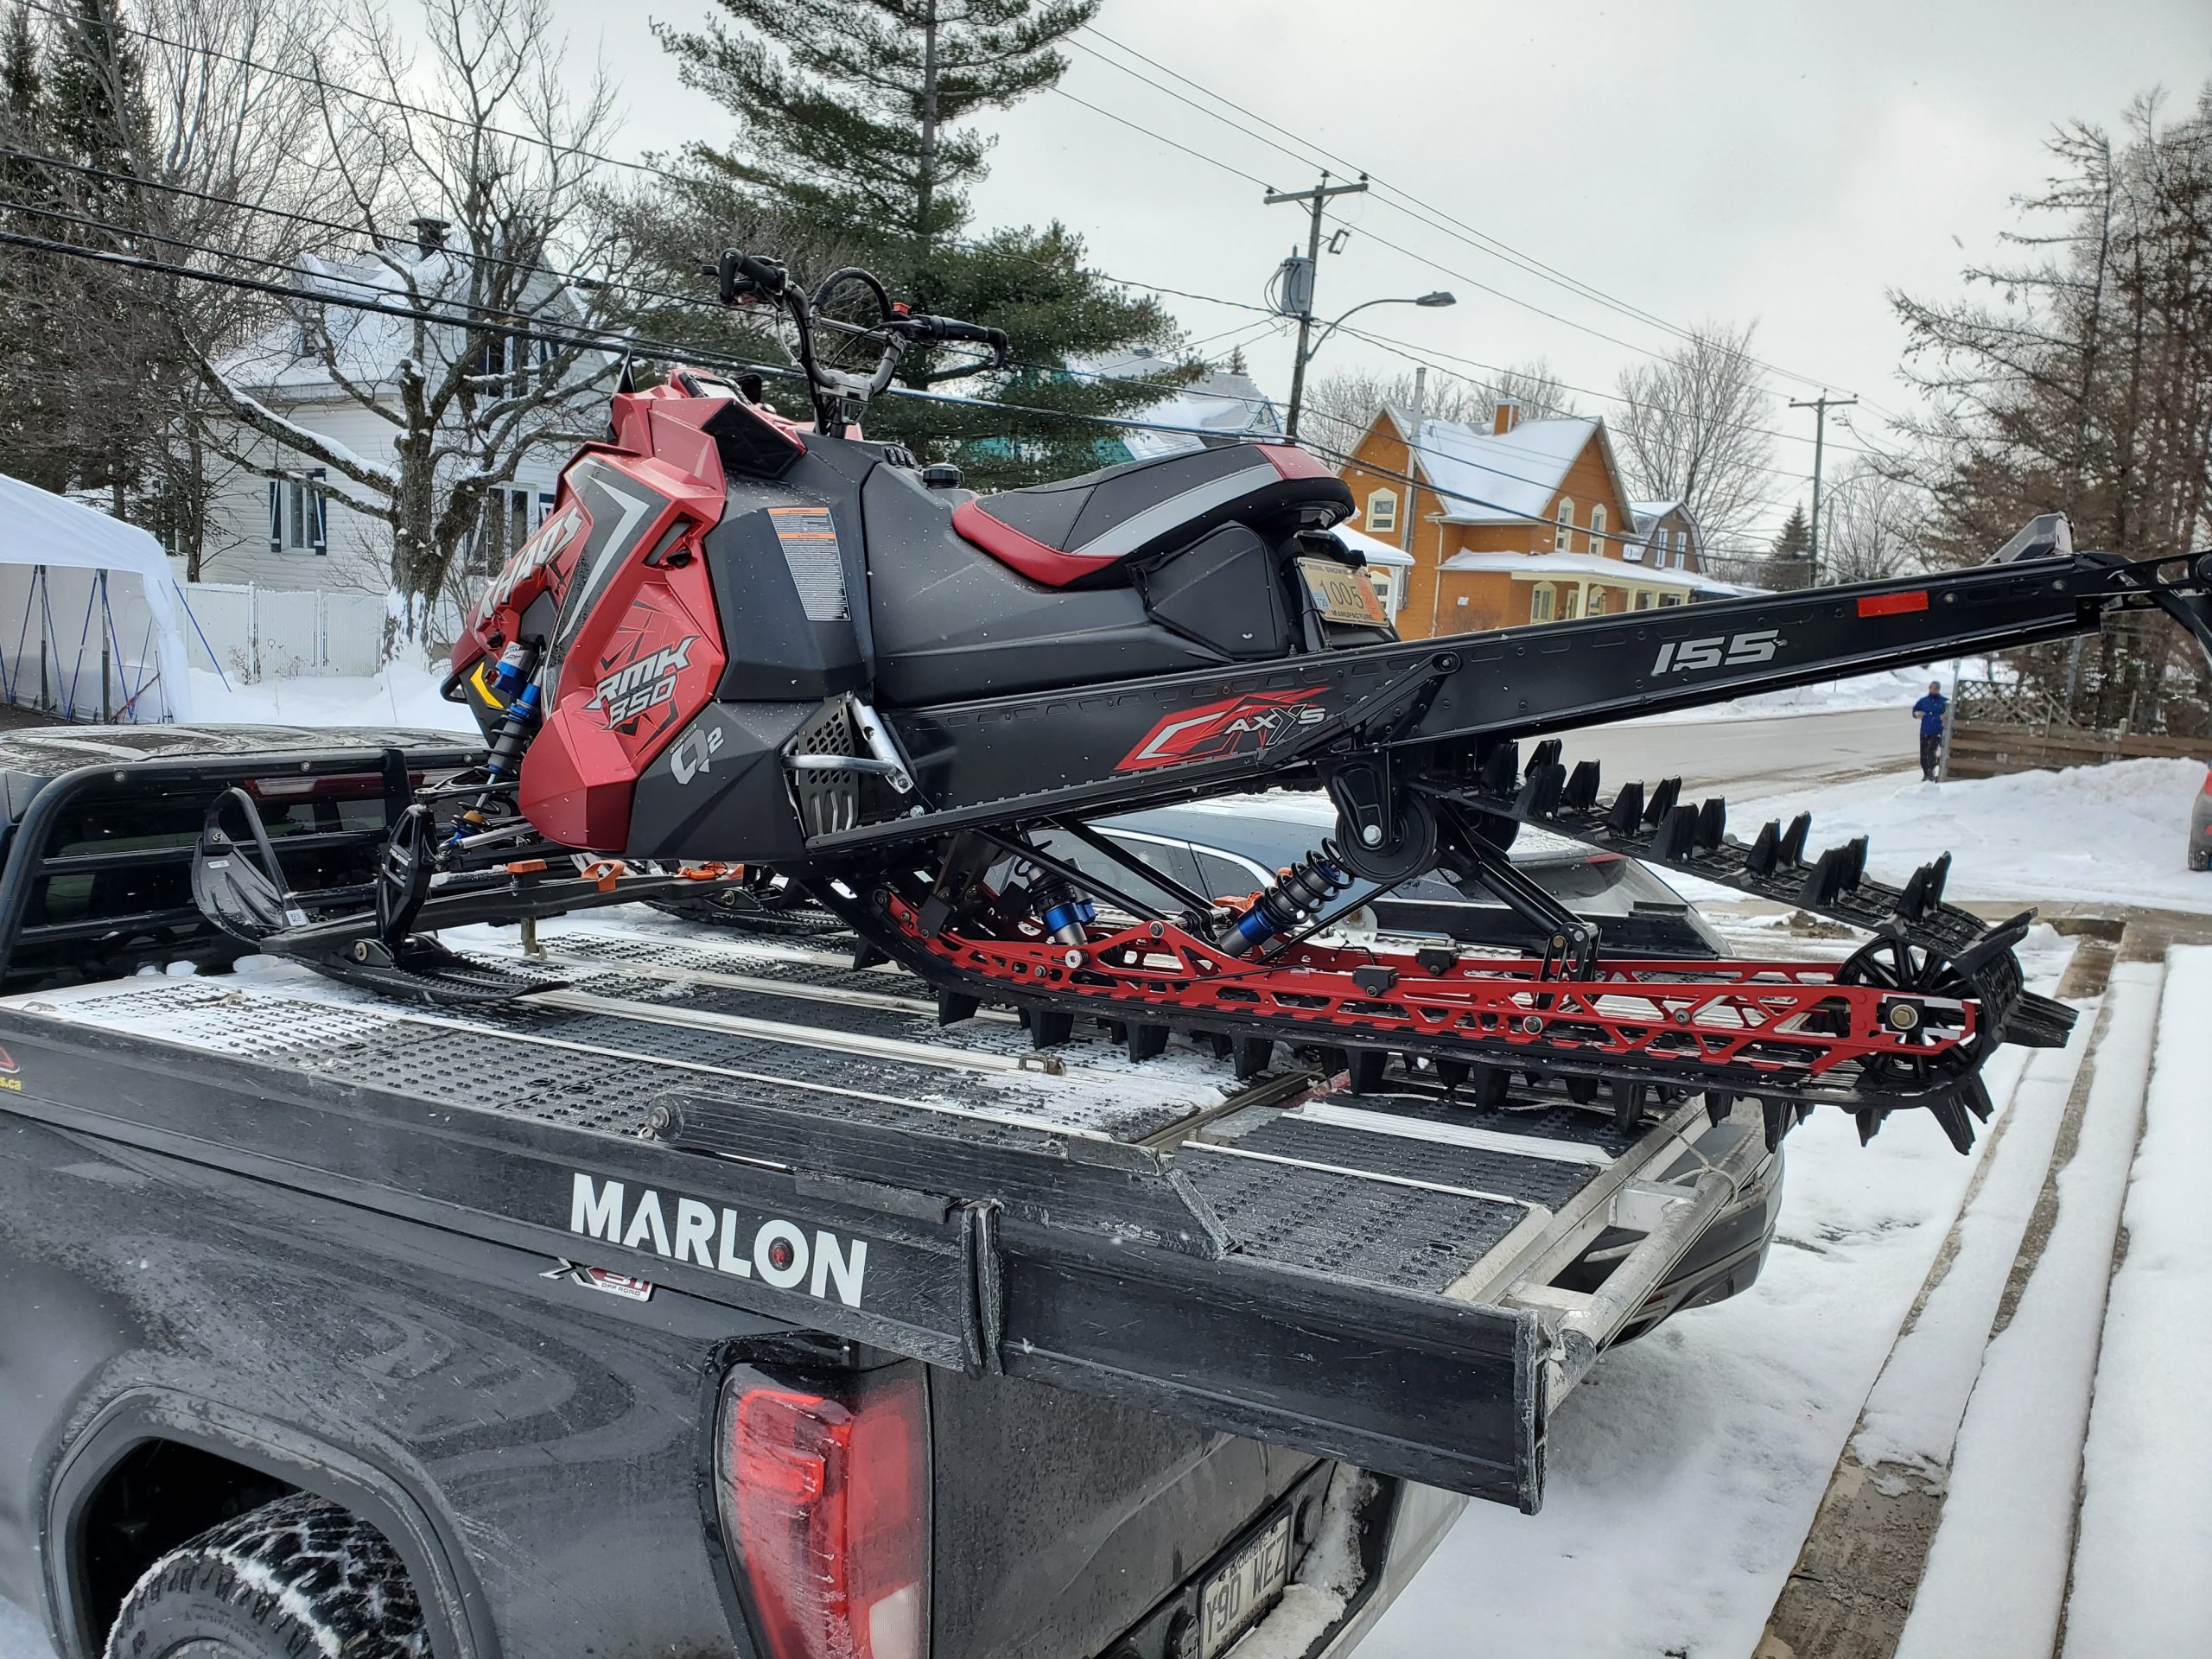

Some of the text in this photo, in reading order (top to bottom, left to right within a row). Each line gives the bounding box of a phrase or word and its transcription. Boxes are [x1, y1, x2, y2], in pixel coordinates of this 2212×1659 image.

[1319, 580, 1364, 609] 1005
[585, 636, 698, 709] RMK
[1652, 630, 1779, 674] 155
[607, 674, 677, 730] 850
[1224, 703, 1326, 747] AXYS
[570, 1173, 868, 1308] MARLON
[601, 1282, 641, 1296] OFF ROAD
[1206, 1573, 1242, 1643] Y90
[1252, 1529, 1287, 1599] WEZ
